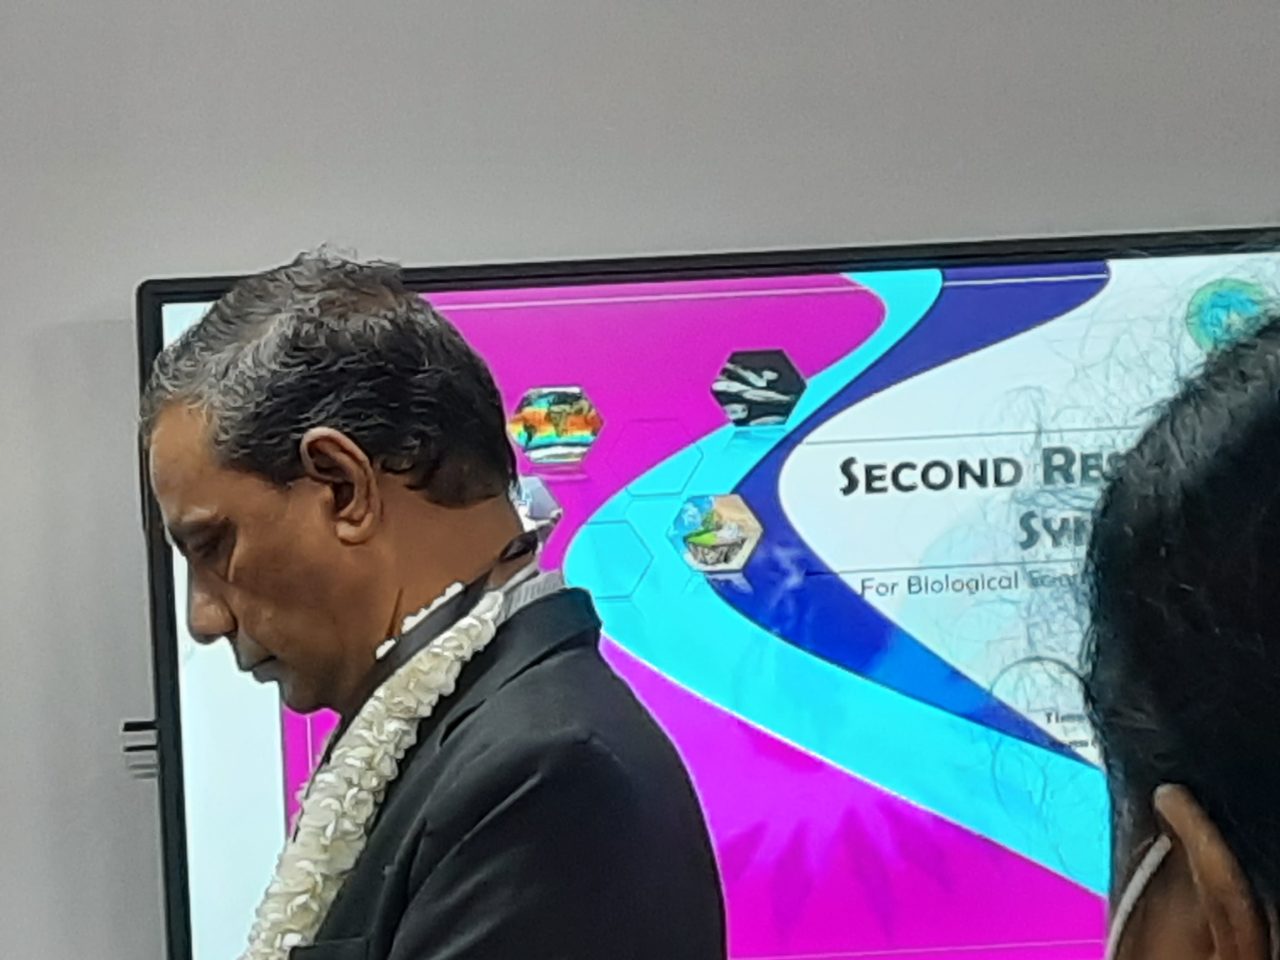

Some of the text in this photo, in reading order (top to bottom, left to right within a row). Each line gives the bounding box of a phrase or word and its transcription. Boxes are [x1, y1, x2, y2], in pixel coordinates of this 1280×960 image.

[839, 455, 1023, 496] SECOND
[860, 577, 899, 598] For
[907, 570, 1019, 595] Biological
